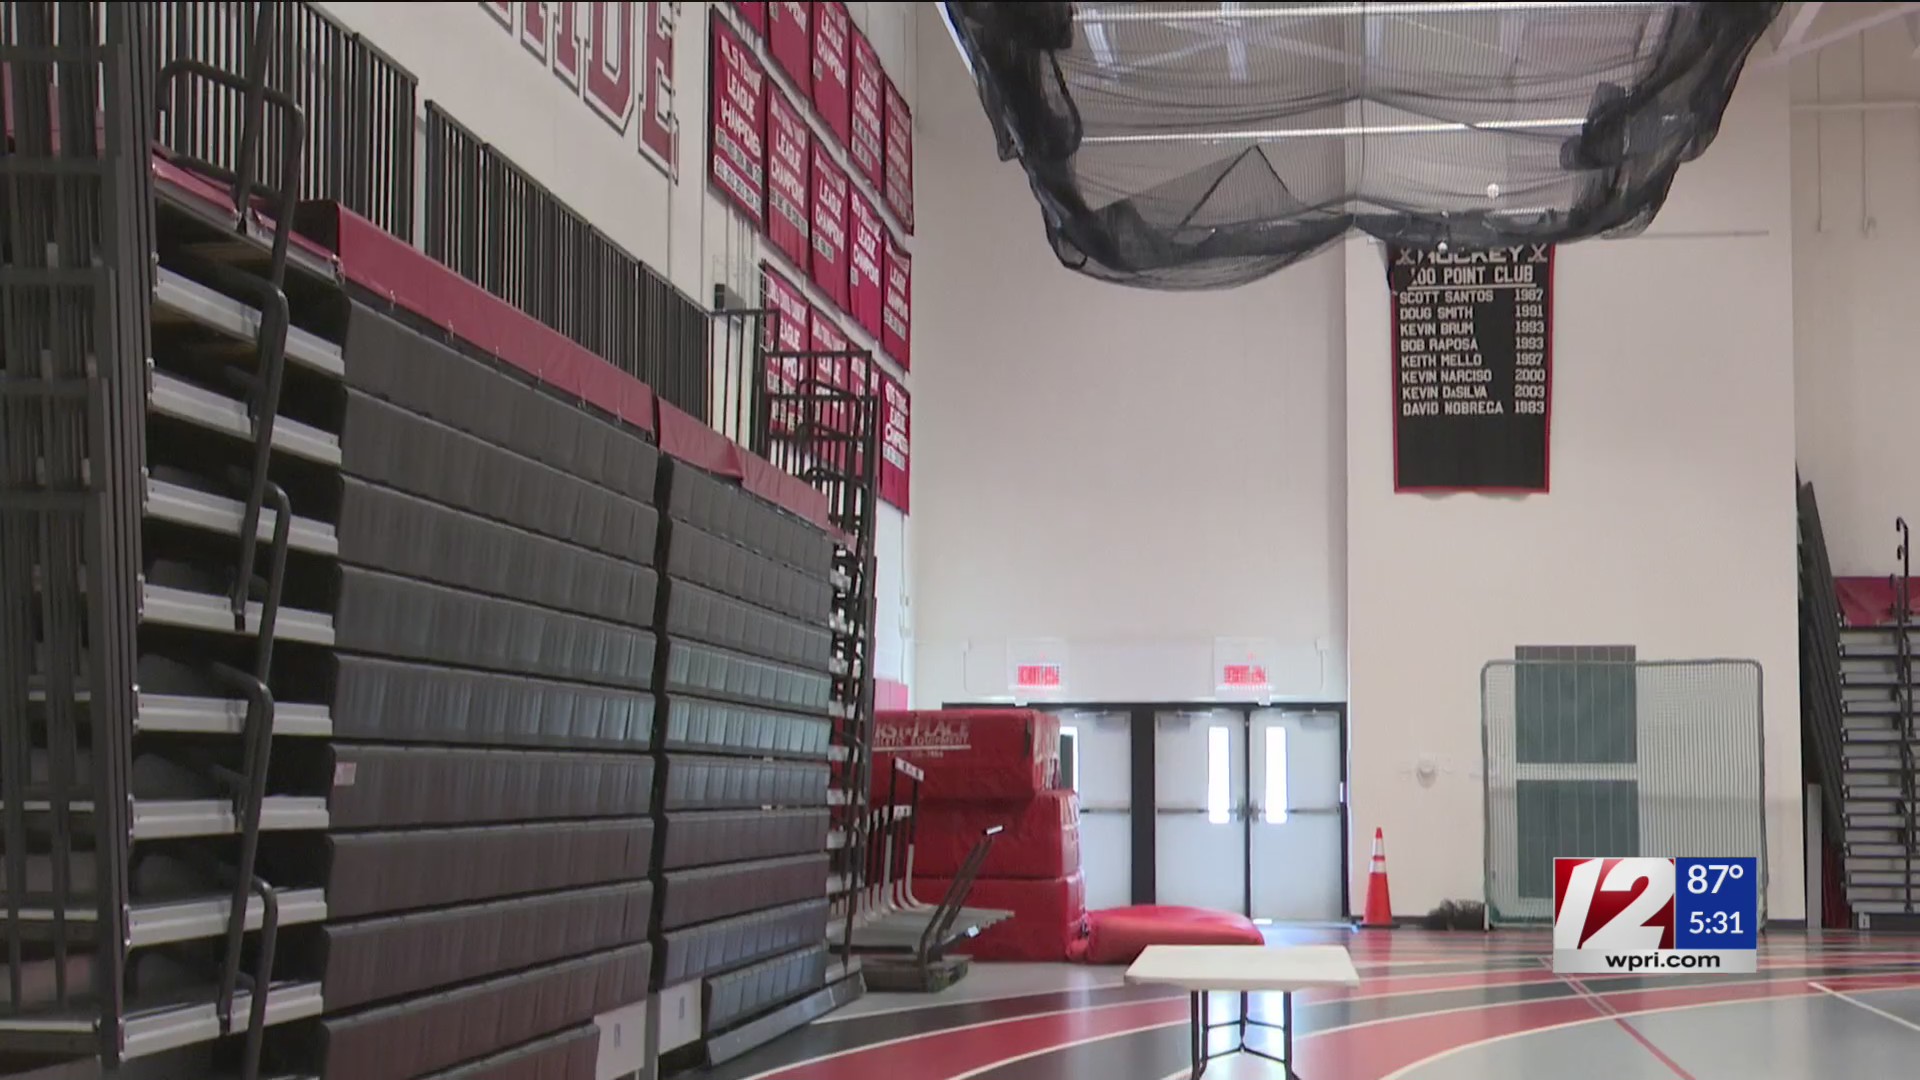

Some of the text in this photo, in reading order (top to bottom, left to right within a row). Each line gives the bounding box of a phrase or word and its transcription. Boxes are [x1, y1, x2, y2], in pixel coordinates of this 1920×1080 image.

[1443, 266, 1486, 285] POINT
[1494, 265, 1533, 283] CLUB
[1400, 291, 1439, 305] SCOTT
[1444, 290, 1494, 303] SANTOS
[1400, 305, 1543, 320] DOUG SMITH 1991
[1400, 323, 1436, 336] KEVIN
[1401, 339, 1425, 352] BOB
[1429, 338, 1478, 350] RAPOSA
[1401, 353, 1543, 368] KEITH MELLO 1997
[1402, 369, 1545, 384] KEVIN NARCISO 2000
[1403, 387, 1438, 400] KEVIN
[1514, 385, 1545, 398] 2003
[1403, 403, 1438, 416] DAVID
